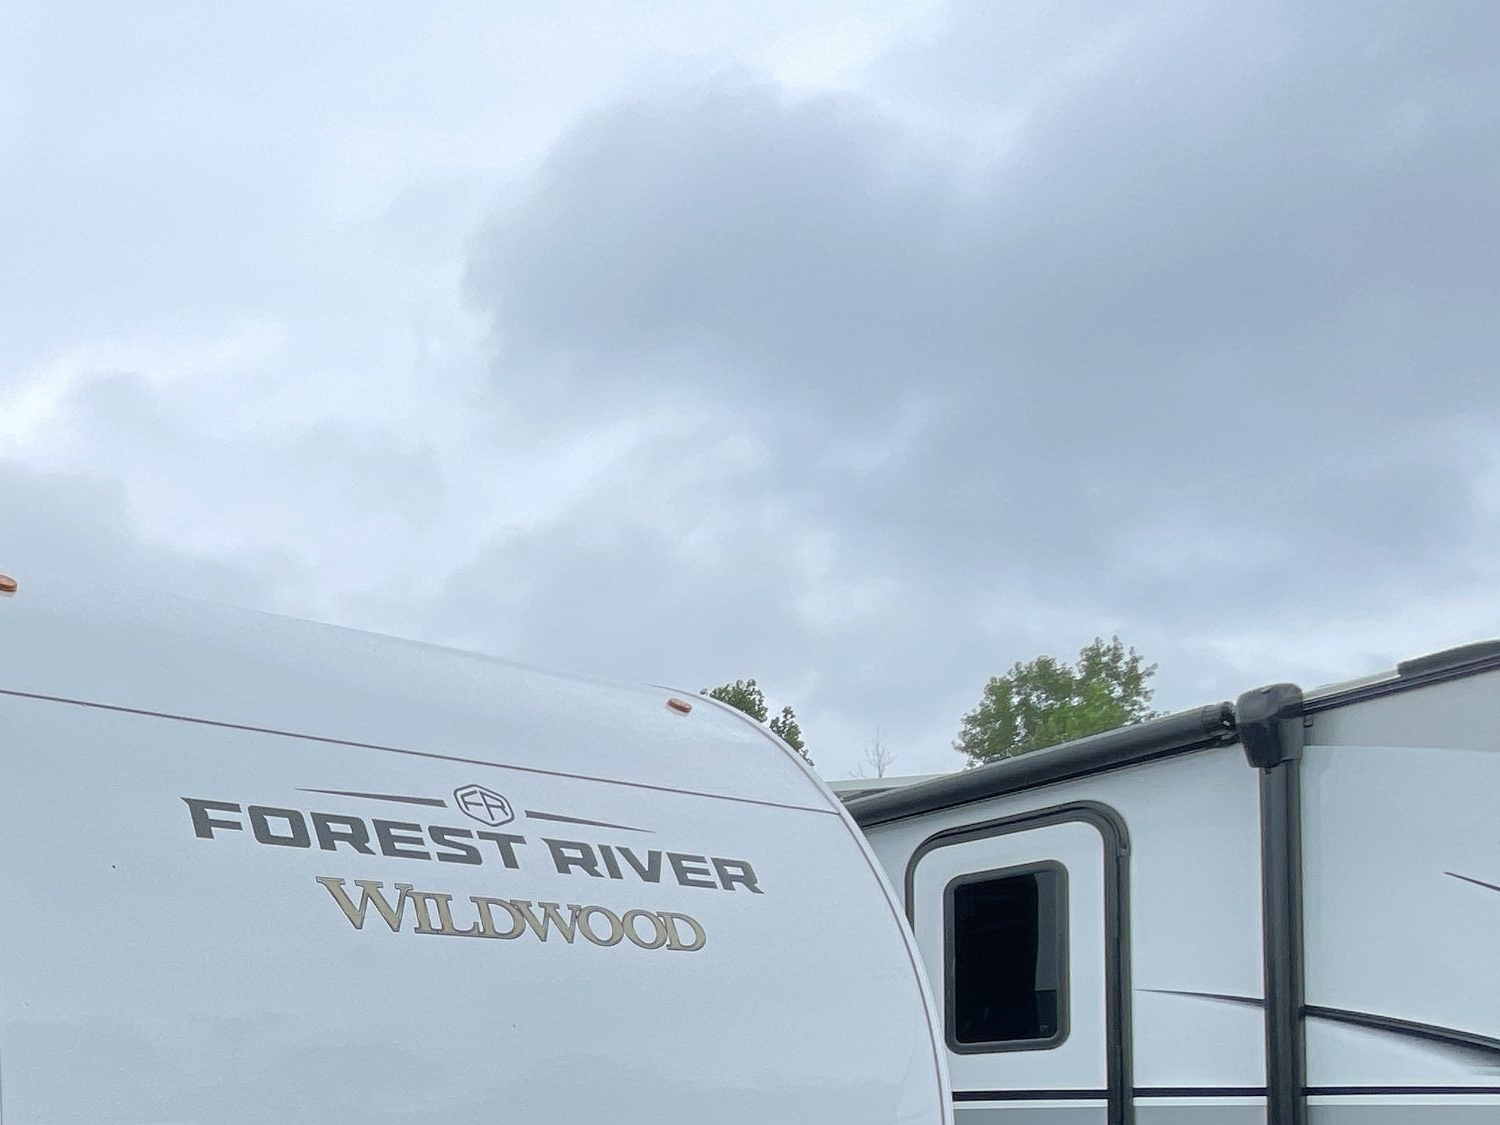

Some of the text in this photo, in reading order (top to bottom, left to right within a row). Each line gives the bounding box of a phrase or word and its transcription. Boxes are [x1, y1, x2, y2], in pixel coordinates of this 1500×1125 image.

[179, 797, 765, 895] FOREST RIVER
[315, 875, 707, 951] WILDWOOD
